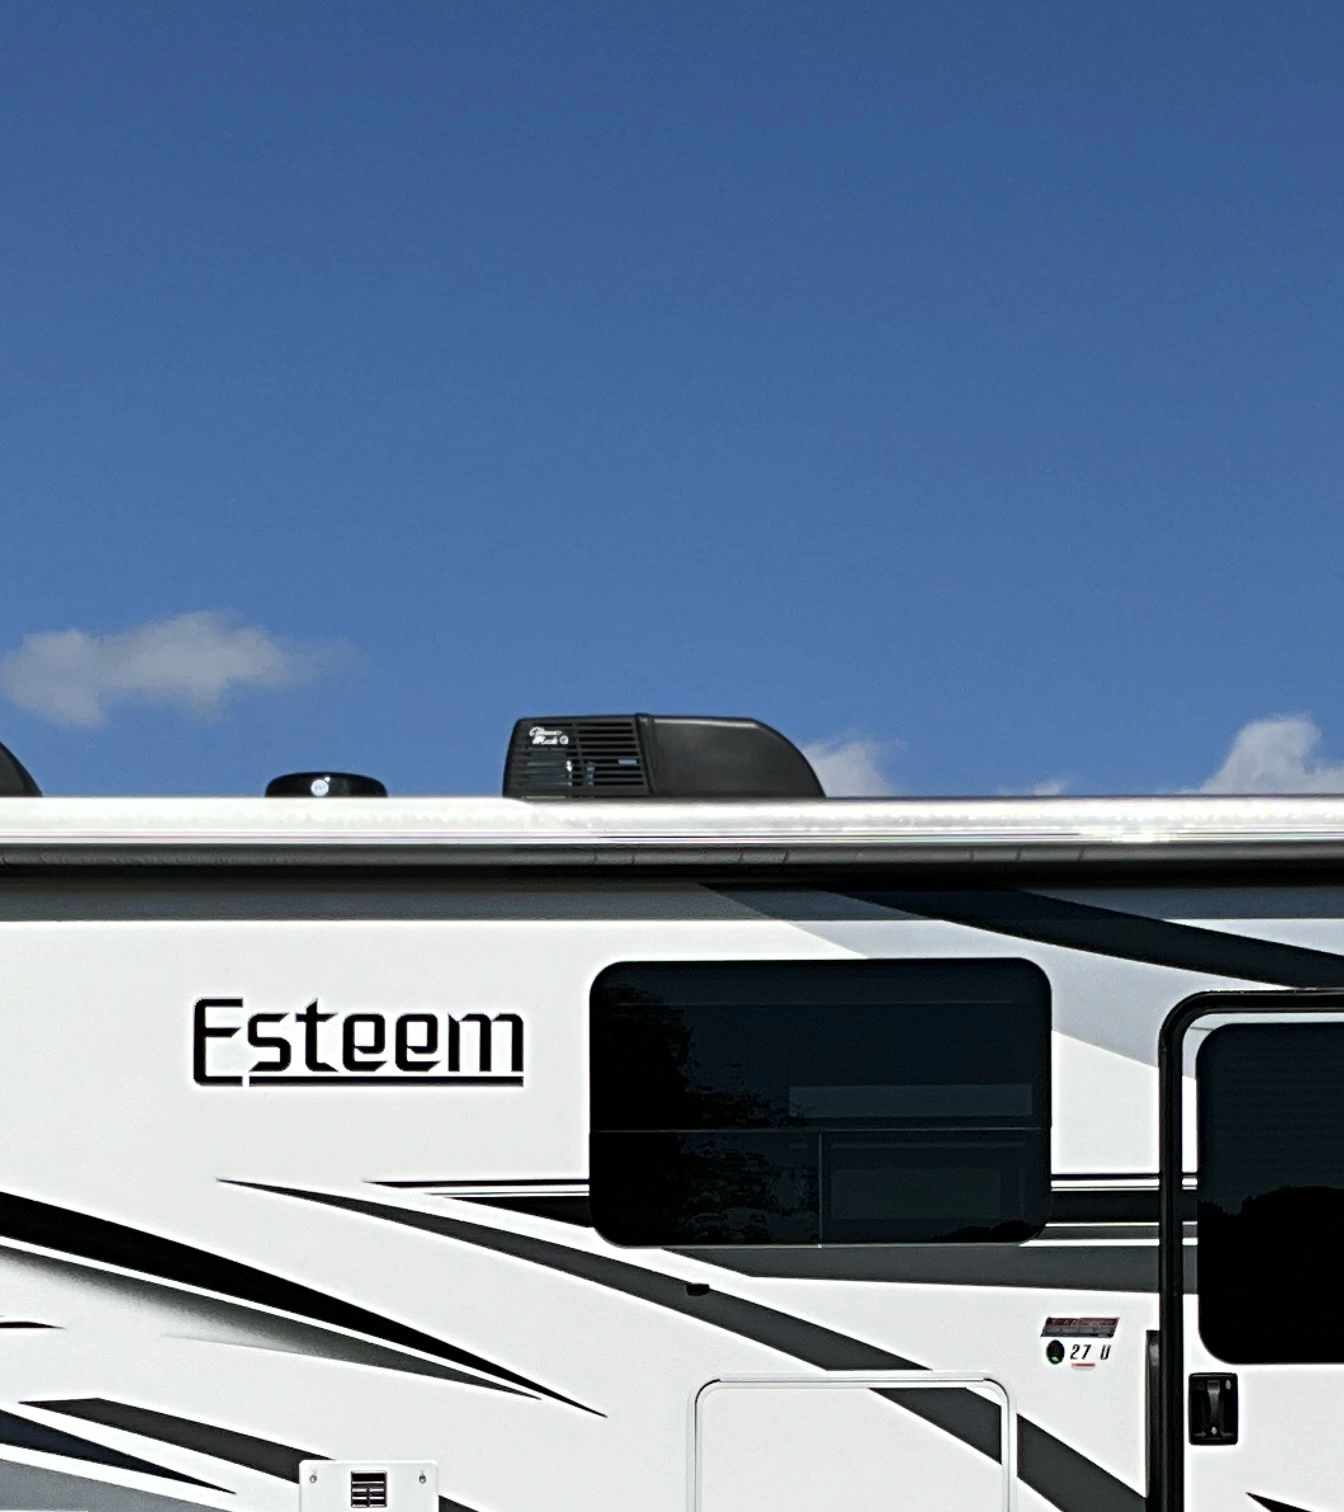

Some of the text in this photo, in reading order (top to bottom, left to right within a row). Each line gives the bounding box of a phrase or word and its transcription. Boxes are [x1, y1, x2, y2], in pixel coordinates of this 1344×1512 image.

[192, 996, 525, 1087] Esteem
[1069, 1343, 1112, 1361] 27 U
